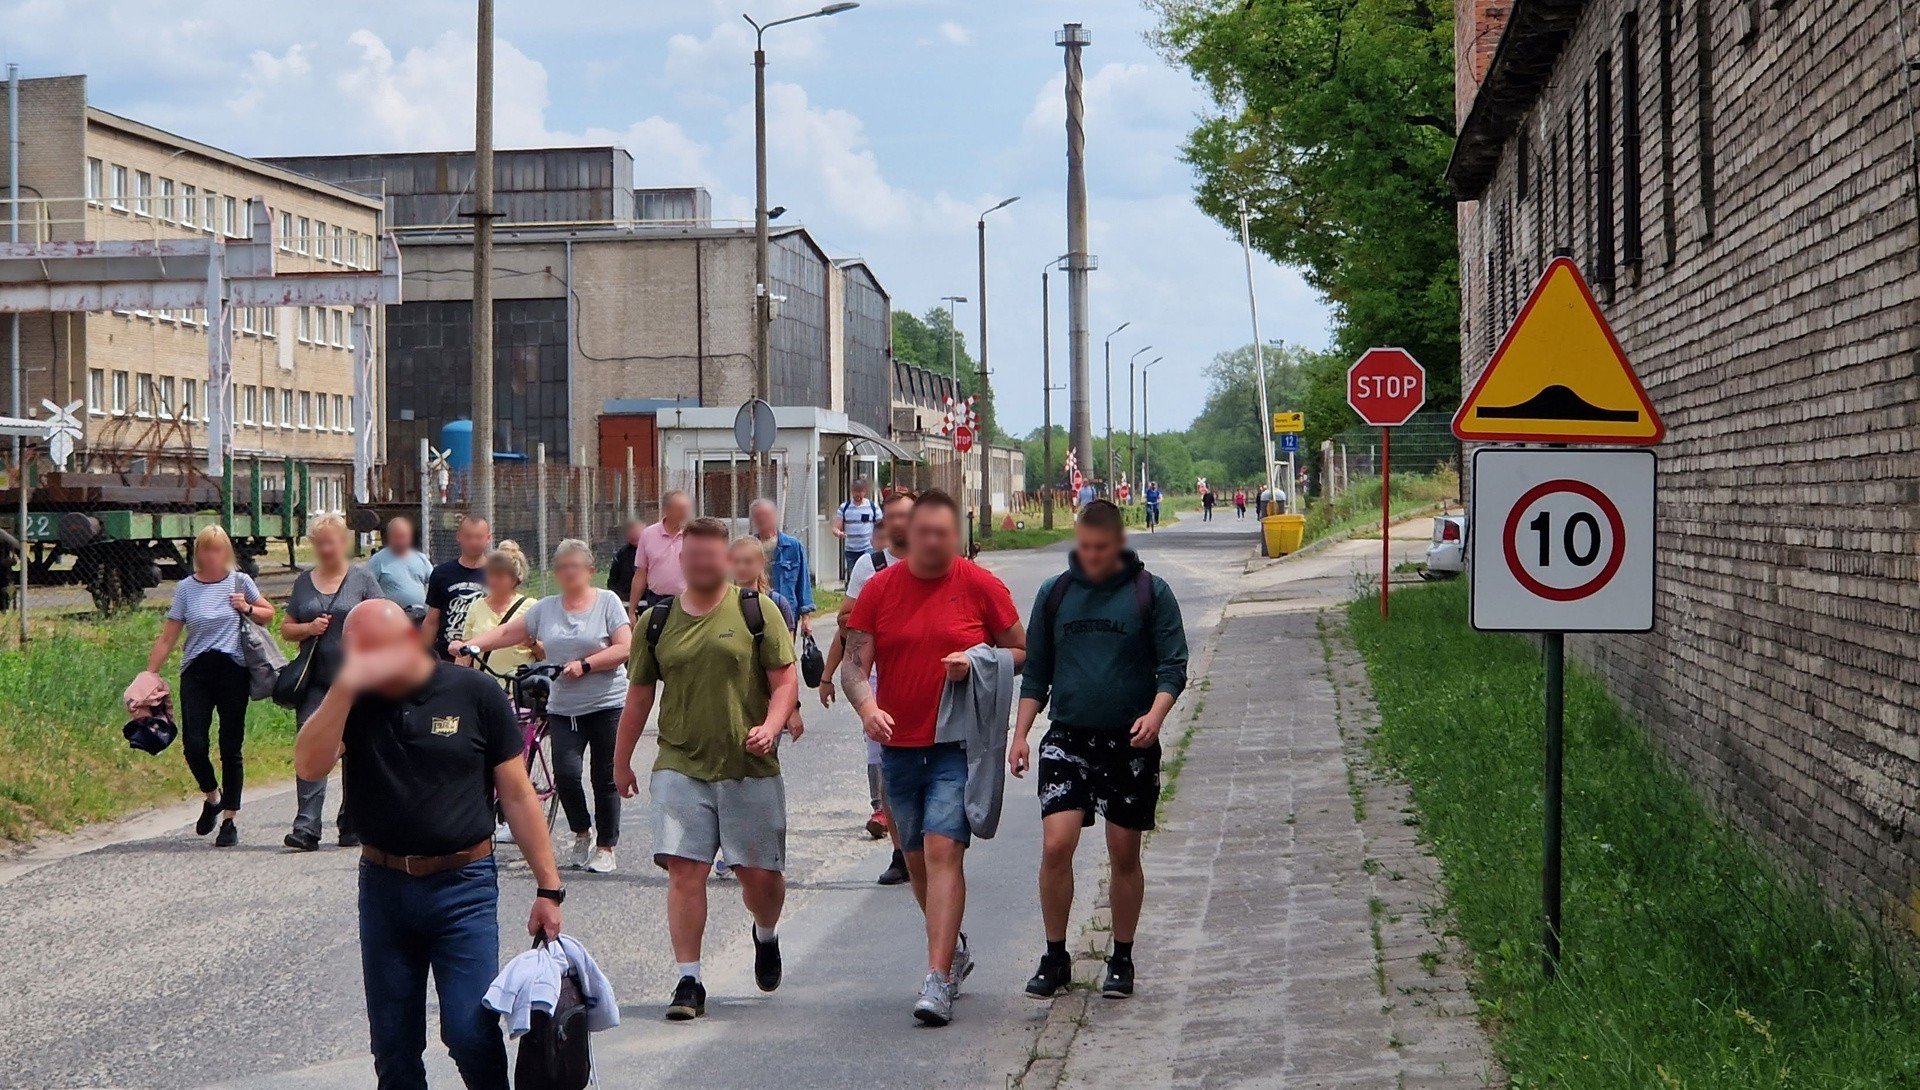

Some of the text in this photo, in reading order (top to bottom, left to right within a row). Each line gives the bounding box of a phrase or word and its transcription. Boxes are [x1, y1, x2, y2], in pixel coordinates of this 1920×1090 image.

[1357, 375, 1417, 398] STOP
[1285, 435, 1294, 447] 12
[1530, 511, 1601, 567] 10
